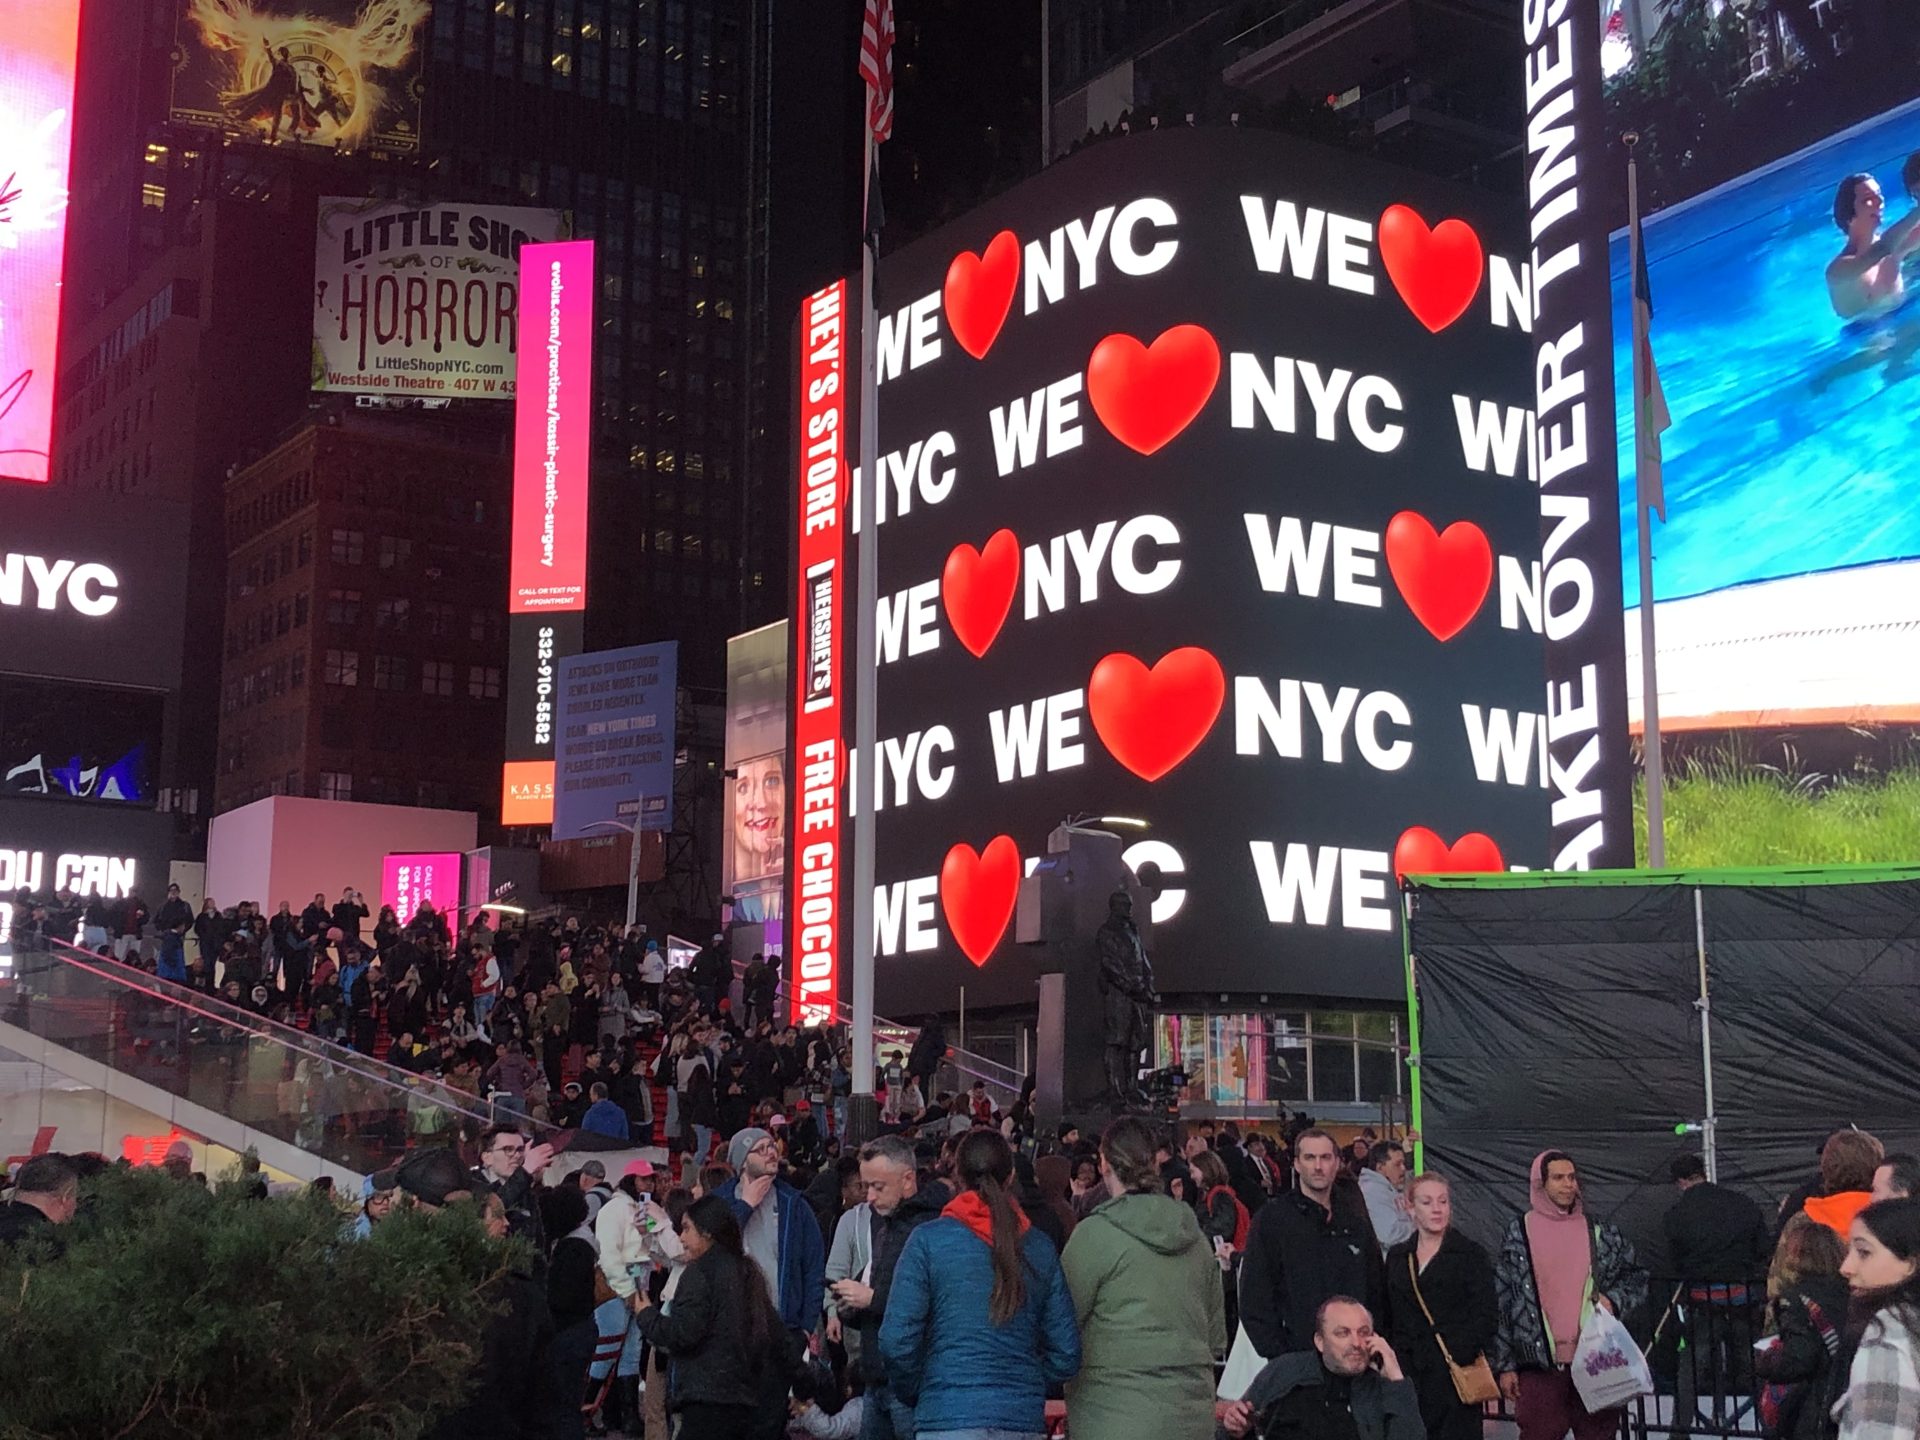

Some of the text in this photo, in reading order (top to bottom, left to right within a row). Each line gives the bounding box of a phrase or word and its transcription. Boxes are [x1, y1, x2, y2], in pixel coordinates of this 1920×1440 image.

[344, 211, 541, 264] LITTLE SHO
[430, 256, 453, 269] OF
[877, 290, 941, 386] WE
[1025, 196, 1178, 315] NYC
[1240, 196, 1374, 295] WE
[328, 372, 390, 387] Westside
[393, 375, 445, 390] Theatre
[454, 378, 479, 391] 407
[483, 379, 496, 391] W
[375, 356, 503, 374] LittleShopNYC.com
[805, 281, 841, 536] HEY'S STORE
[990, 372, 1084, 477] WE
[1231, 353, 1404, 453] NYC
[1537, 322, 1595, 641] OVER
[814, 577, 832, 691] HERSHEY'S
[876, 579, 940, 667] WE
[1025, 515, 1181, 621] NYC
[1244, 513, 1383, 608] WE
[535, 627, 553, 744] 332-910-5582
[989, 689, 1085, 783] WE
[1235, 676, 1412, 770] NYC
[803, 738, 835, 833] FREE
[55, 854, 136, 898] CAN
[872, 876, 939, 957] WE
[1250, 841, 1391, 932] WE
